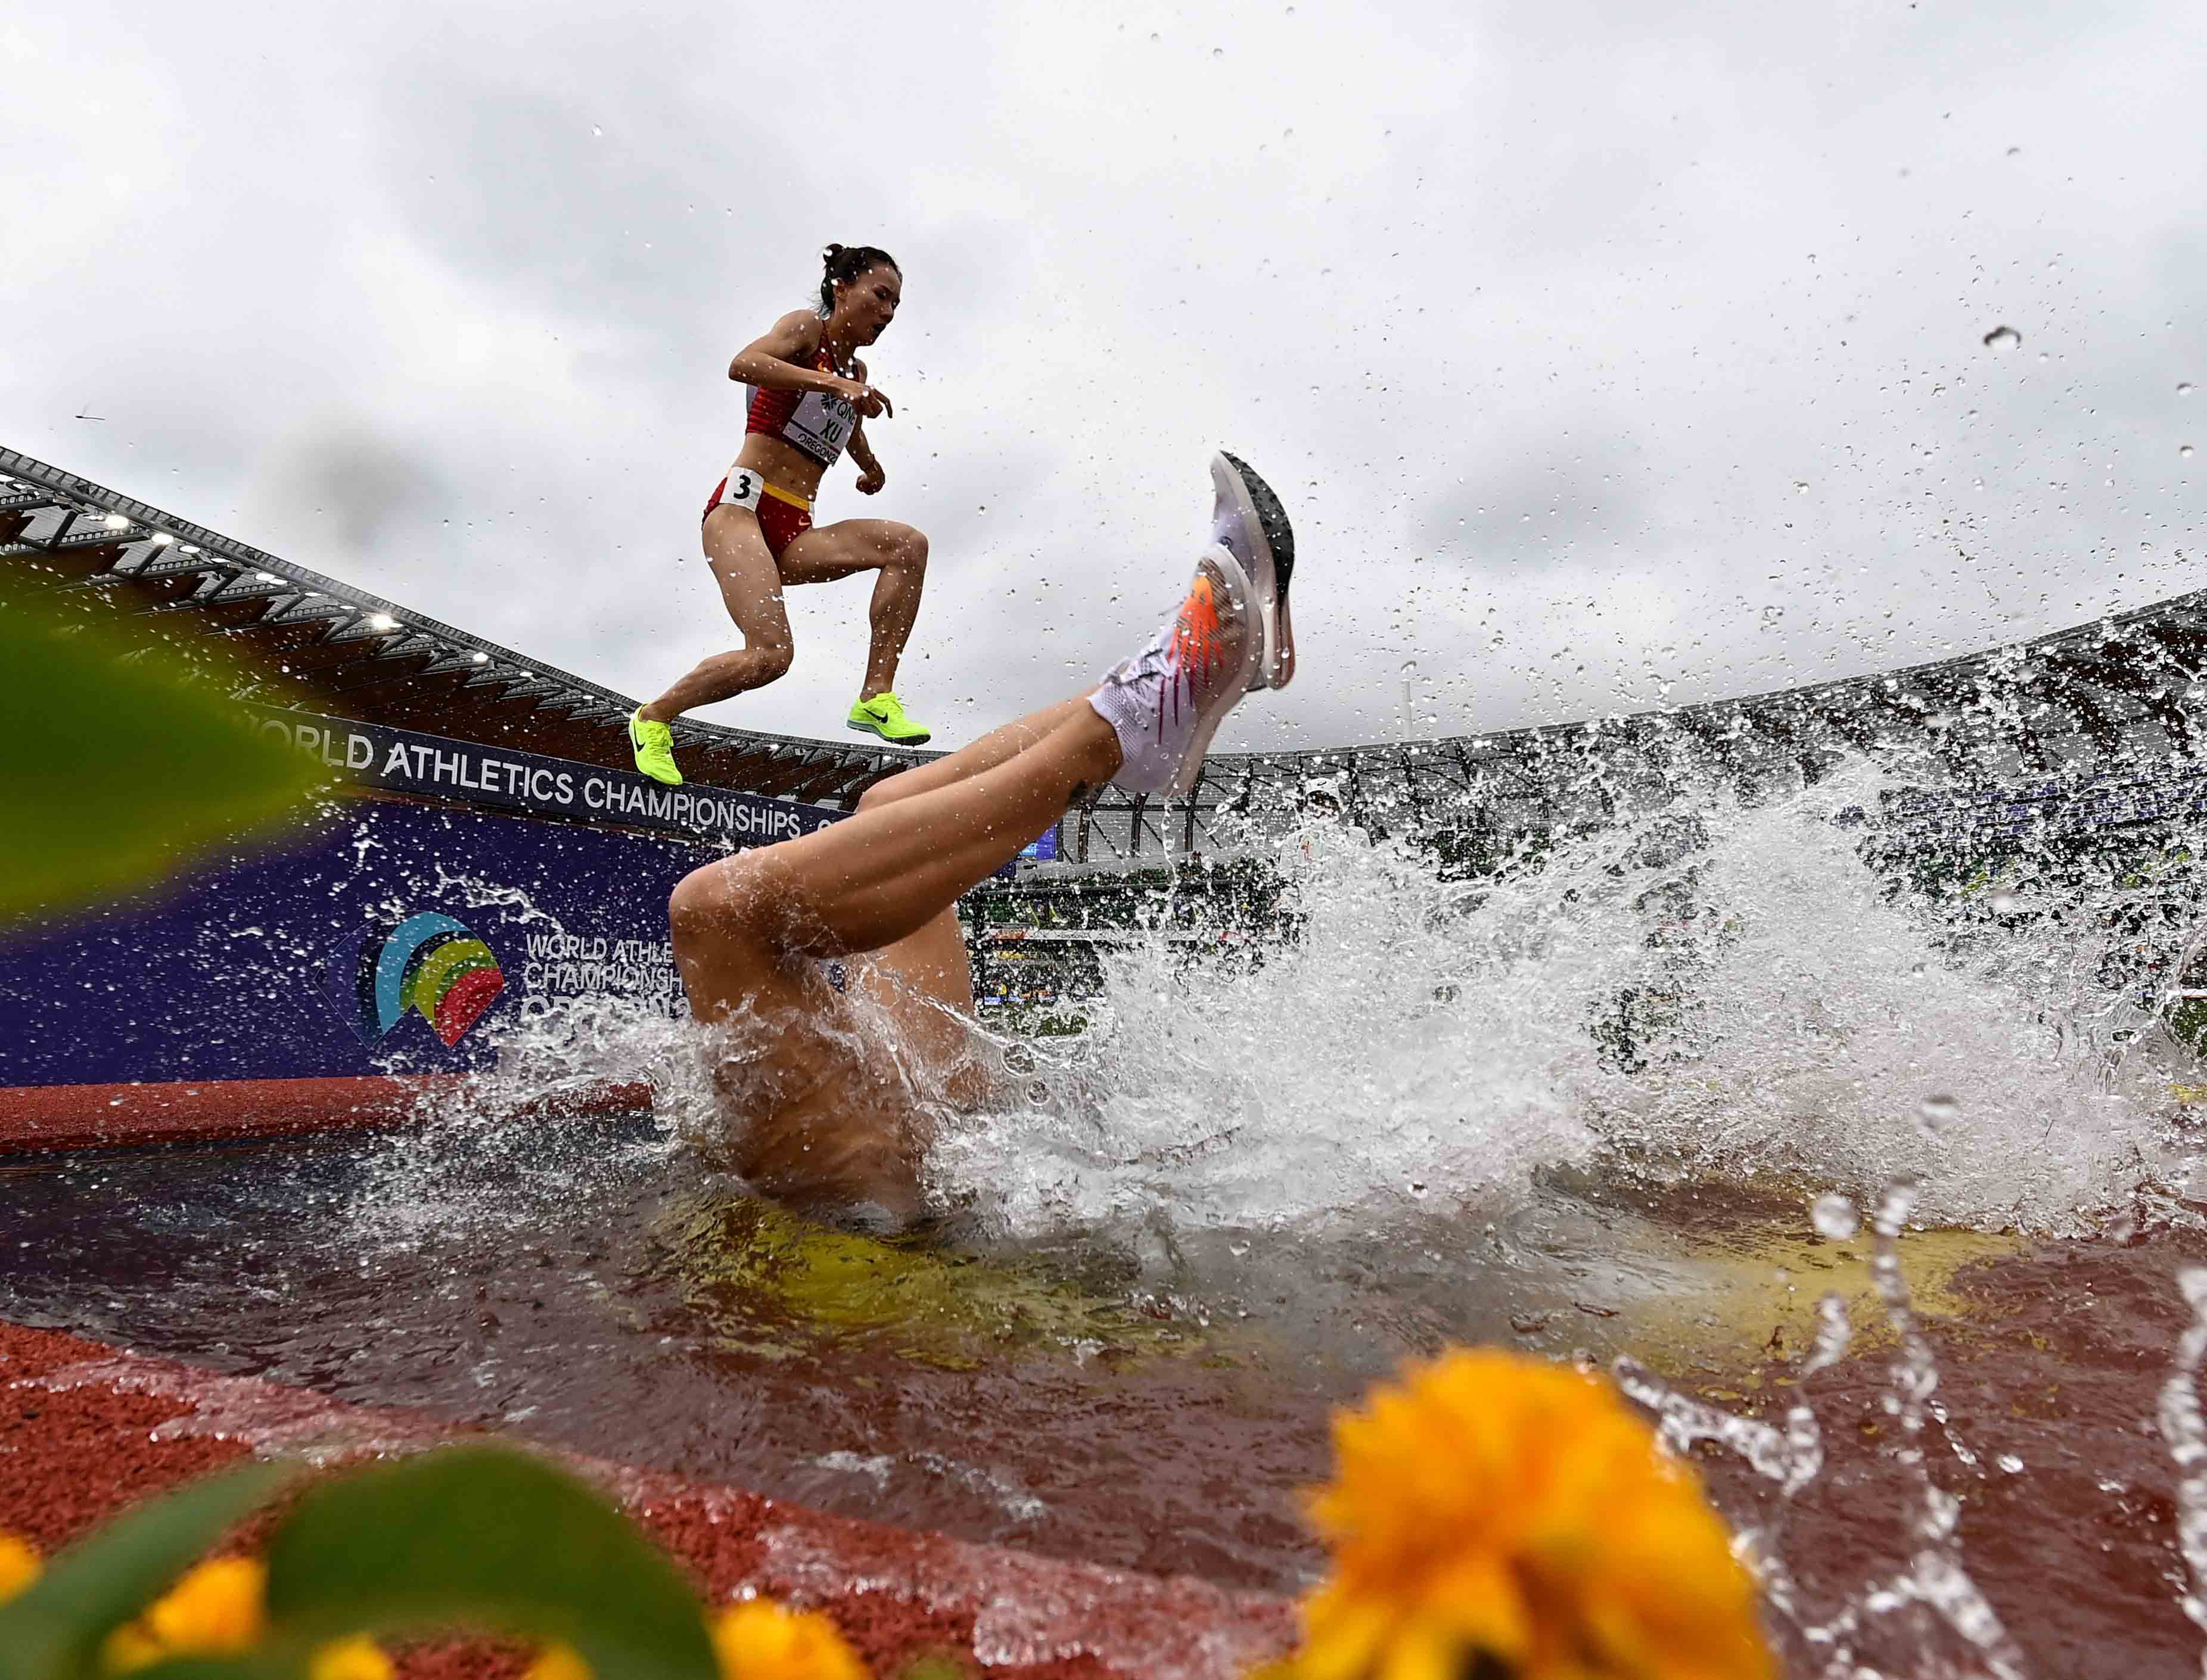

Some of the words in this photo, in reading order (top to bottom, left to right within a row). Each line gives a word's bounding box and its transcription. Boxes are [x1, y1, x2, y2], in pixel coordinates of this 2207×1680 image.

[820, 419, 843, 443] XU
[733, 474, 751, 499] 3
[249, 715, 374, 769] ORLD
[383, 742, 573, 804] ATHLETICS
[585, 778, 800, 839] CHAMPIONSHIPS
[526, 934, 607, 960] WORLD
